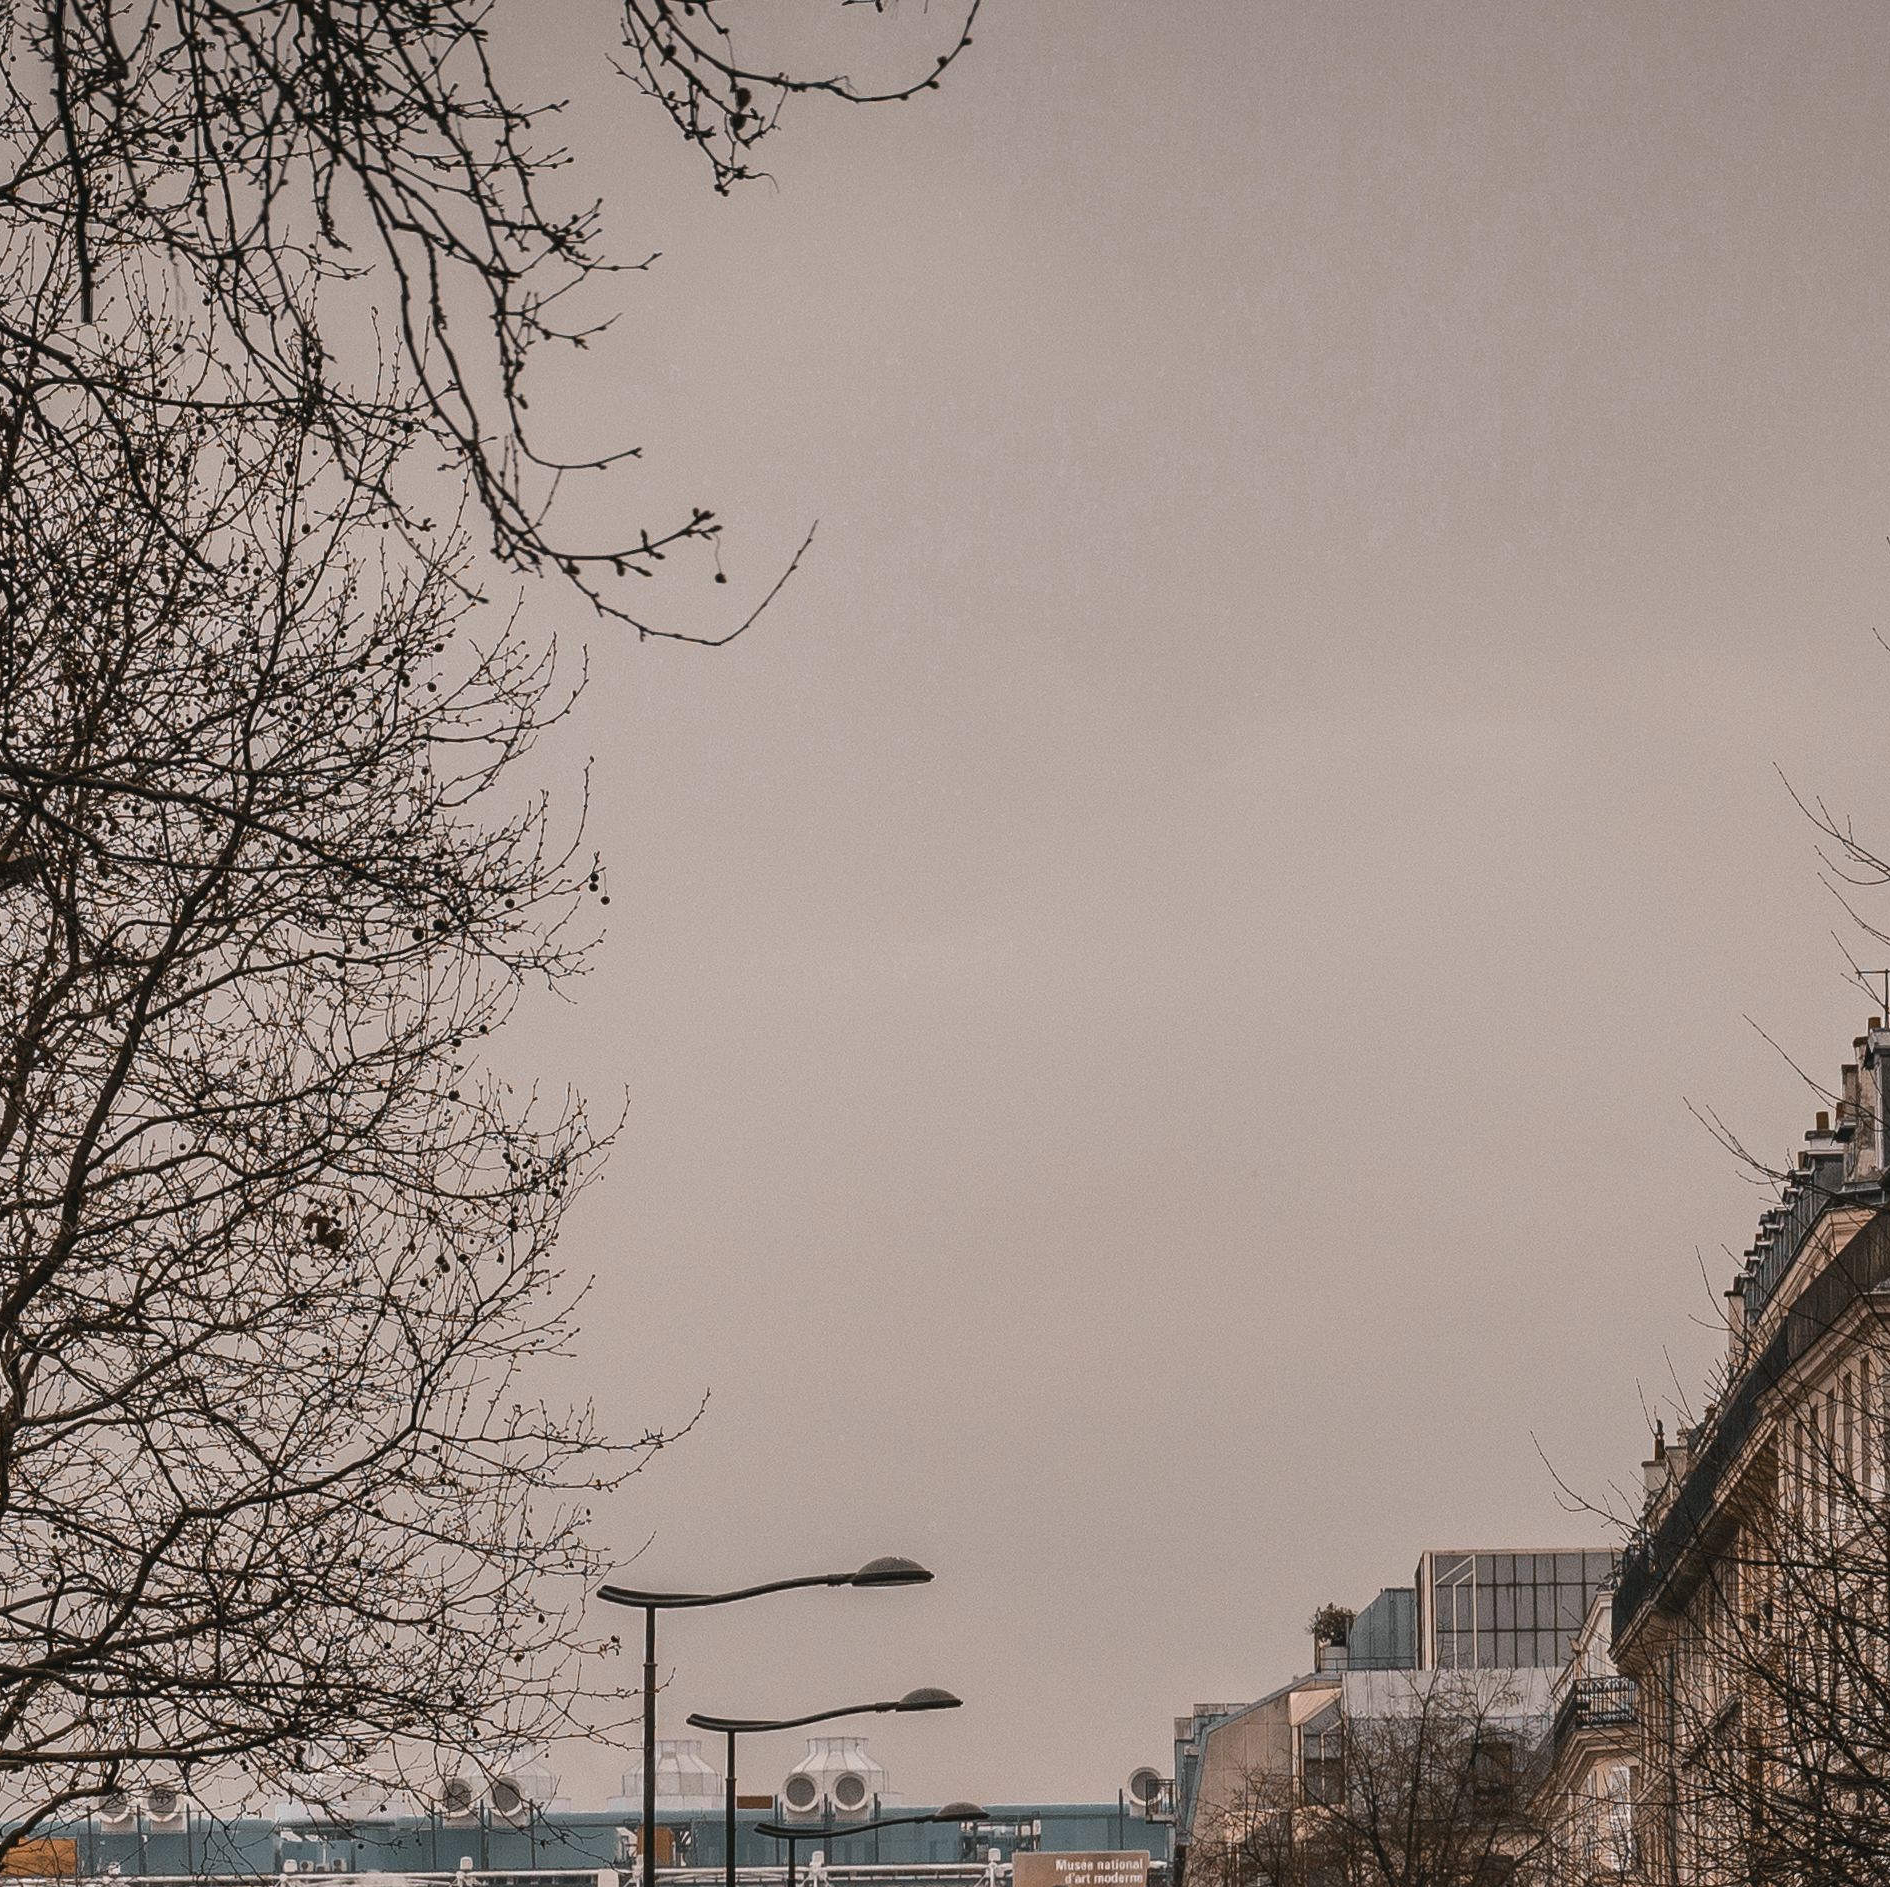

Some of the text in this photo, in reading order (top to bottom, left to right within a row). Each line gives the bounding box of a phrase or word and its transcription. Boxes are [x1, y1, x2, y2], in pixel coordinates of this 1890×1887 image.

[1055, 1858, 1143, 1871] Musée national
[1064, 1872, 1143, 1885] d'art moderne
